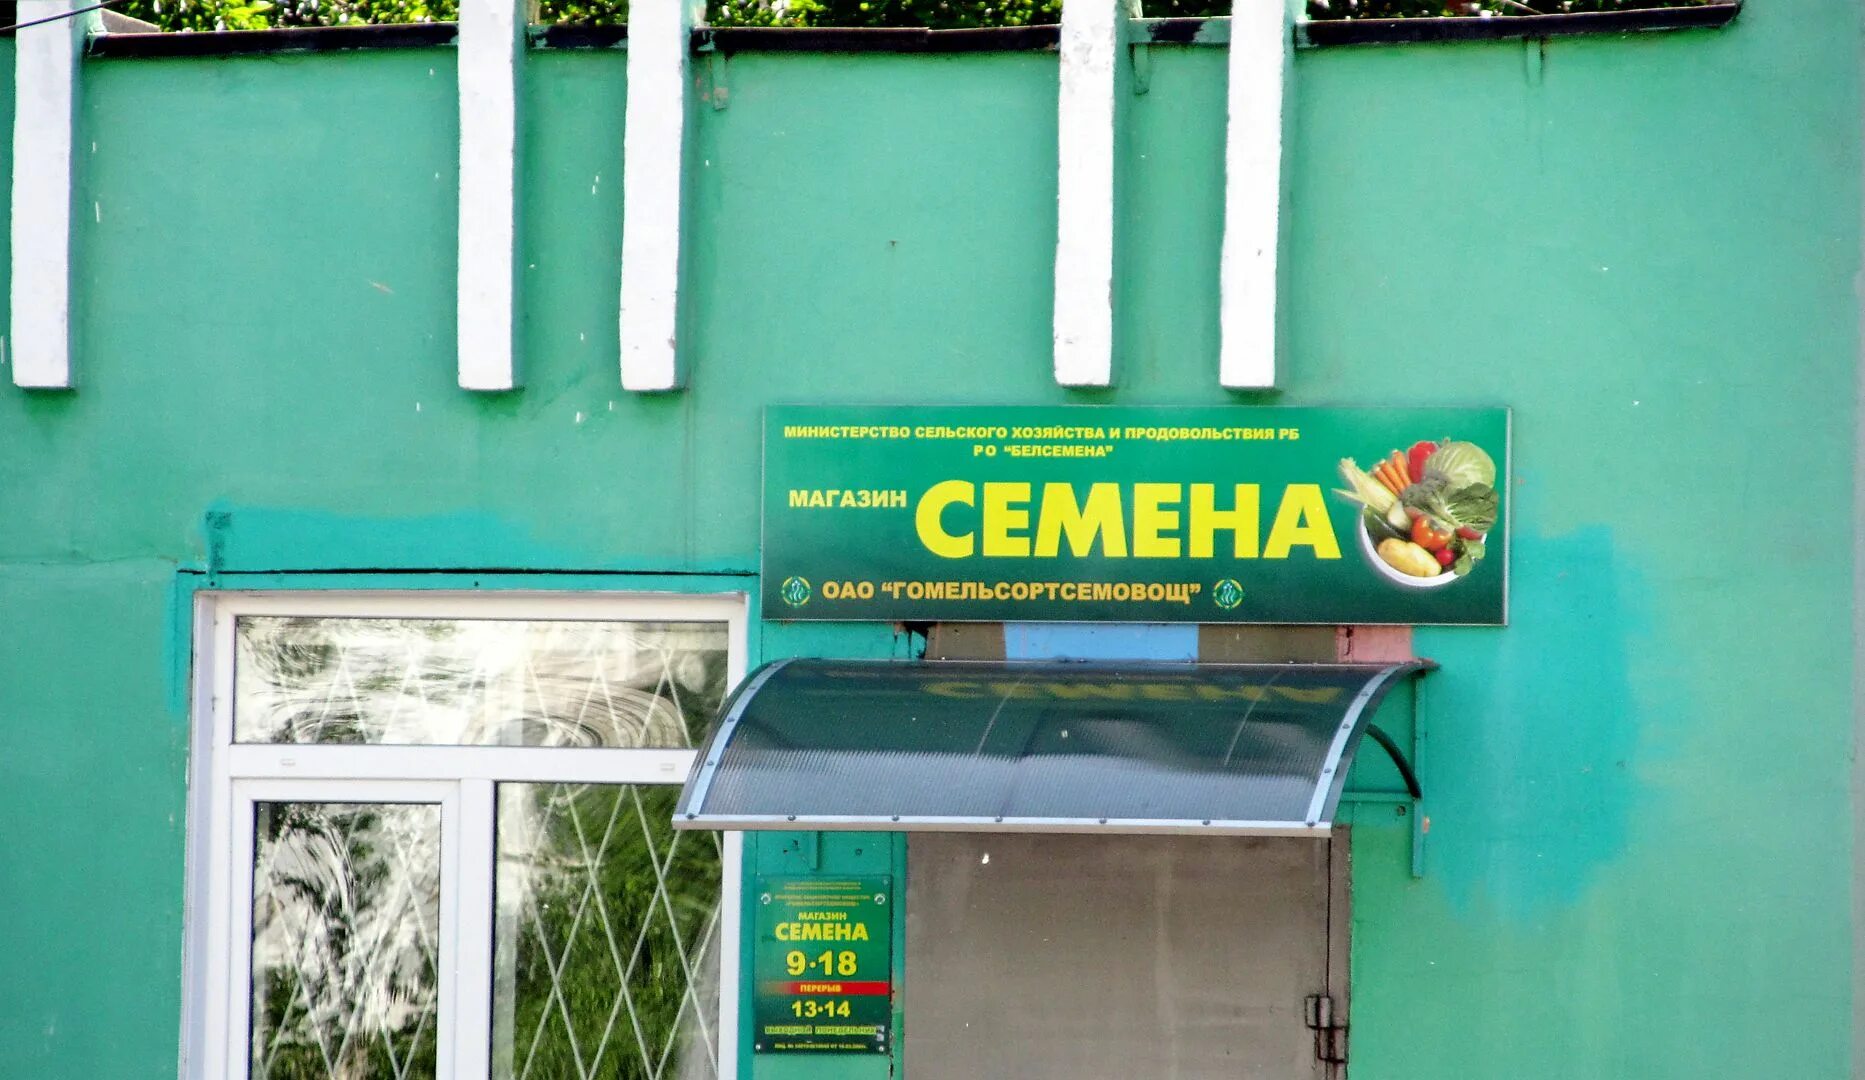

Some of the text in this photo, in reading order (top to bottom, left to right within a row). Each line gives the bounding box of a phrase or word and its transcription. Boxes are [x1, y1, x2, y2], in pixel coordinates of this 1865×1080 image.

[783, 425, 1300, 442] МИНИСТЕРСТВО СЕЛЬСКОГО ХОЗЯЙСТВА И ПРОДОВОЛЬСТВИЯ РБ
[1003, 444, 1114, 458] “БЕЛСЕМЕНА”
[788, 480, 1342, 559] МАГАЗИН СЕМЕНА
[822, 580, 1202, 605] ОАО “ГОМЕЛЬСОРТСЕМОВОЩ”
[798, 912, 847, 921] МАГАЗИН
[775, 922, 869, 941] СЕМЕНА
[799, 984, 842, 993] ПЕРЕРЫВ
